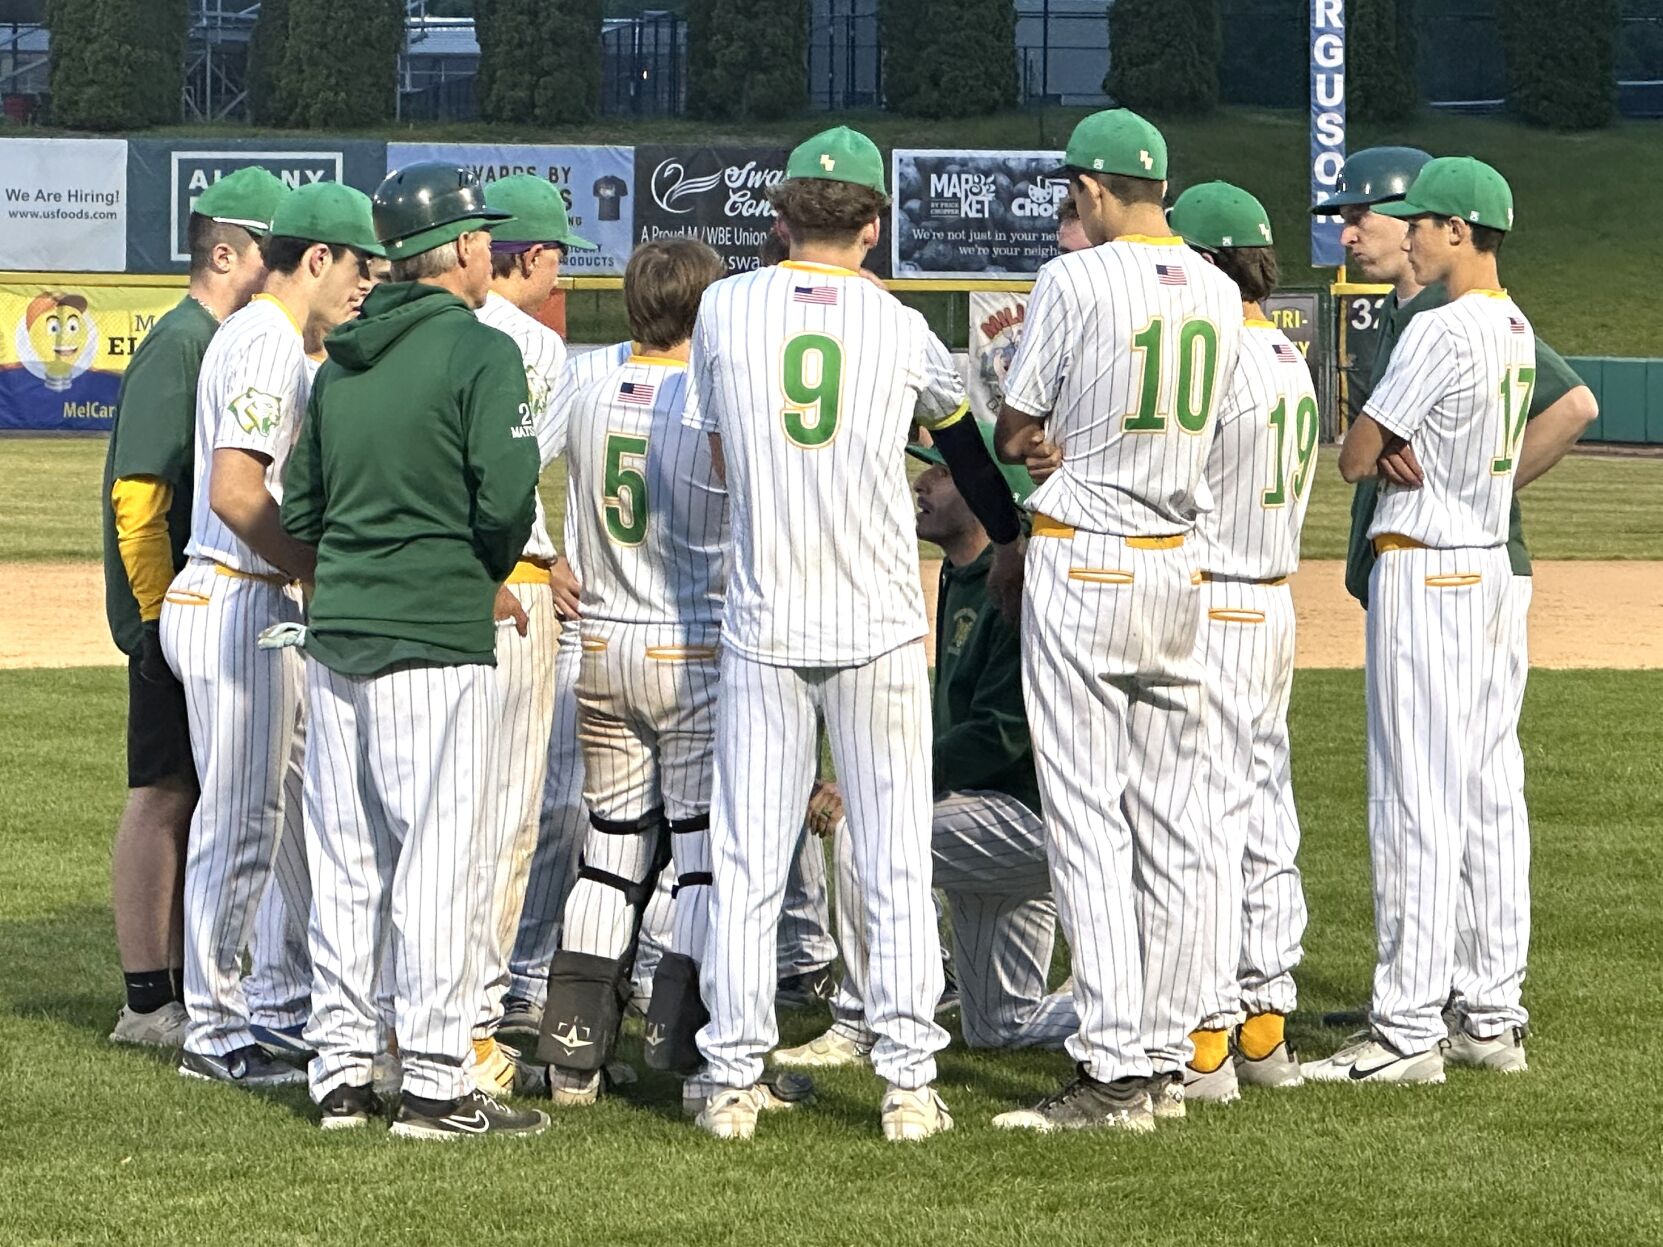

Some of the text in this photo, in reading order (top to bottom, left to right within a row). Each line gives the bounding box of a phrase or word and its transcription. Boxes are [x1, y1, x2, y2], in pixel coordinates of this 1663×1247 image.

[188, 169, 326, 191] ANY
[548, 166, 572, 184] BY
[5, 188, 120, 206] We Are Hiring!
[8, 208, 117, 220] www.usfoods.com
[640, 225, 649, 243] A
[912, 228, 944, 240] We're
[947, 229, 966, 240] not
[968, 229, 992, 242] just
[995, 230, 1006, 240] in
[1009, 231, 1039, 243] your
[959, 245, 989, 256] we're
[992, 247, 1020, 258] your
[1271, 309, 1308, 328] TRI-
[1122, 315, 1219, 436] 10
[780, 331, 847, 449] 9
[518, 402, 532, 425] 2
[1491, 364, 1535, 474] 17
[1261, 395, 1319, 508] 19
[601, 431, 650, 548] 5
